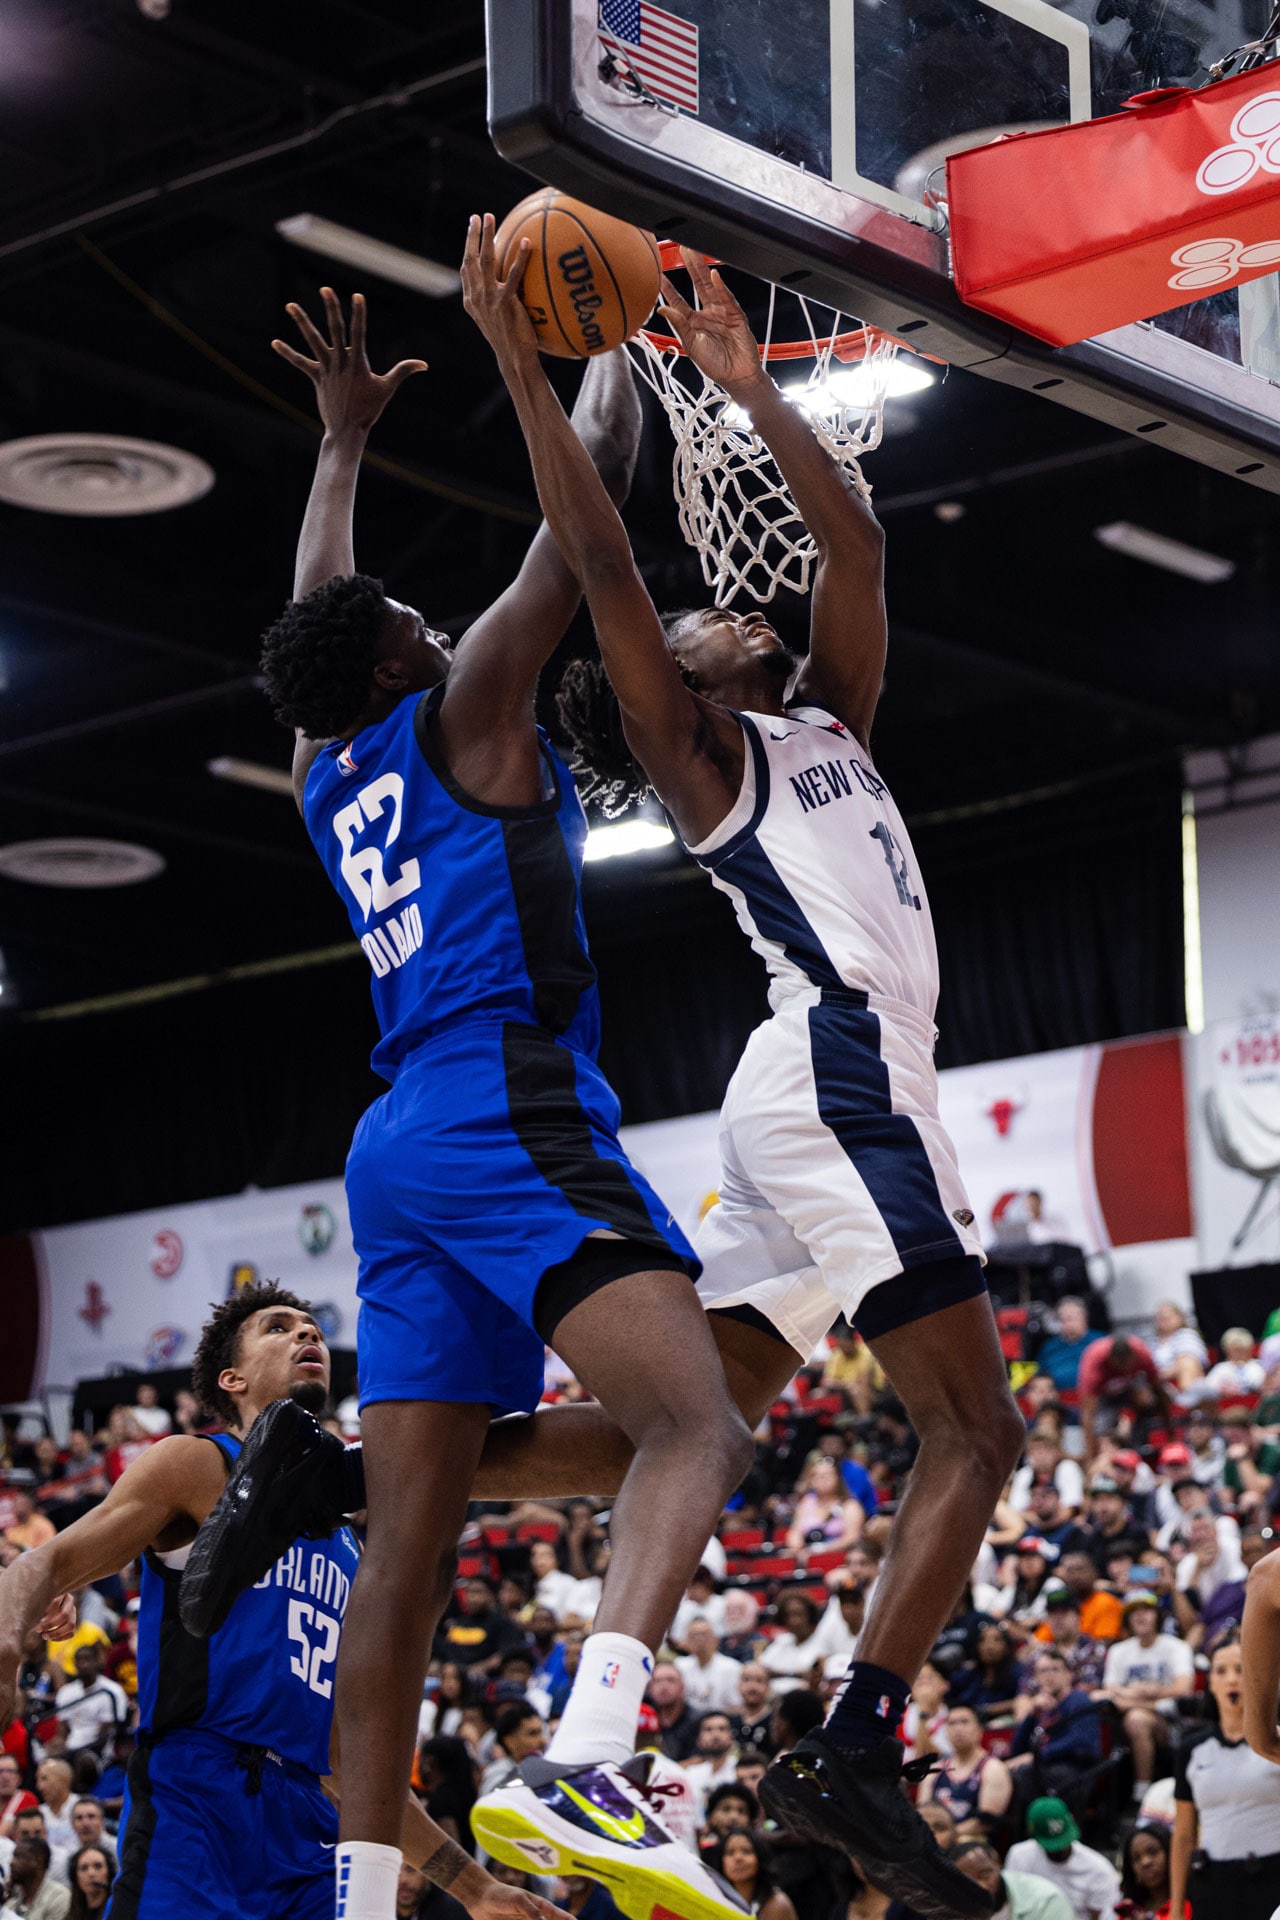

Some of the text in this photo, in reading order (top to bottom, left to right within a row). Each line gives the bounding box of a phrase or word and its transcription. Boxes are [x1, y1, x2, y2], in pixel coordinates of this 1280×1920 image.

[558, 242, 606, 350] Wilson
[789, 760, 852, 813] NEW
[333, 772, 421, 924] 62
[360, 902, 423, 979] DIAKO
[287, 1598, 340, 1700] 52
